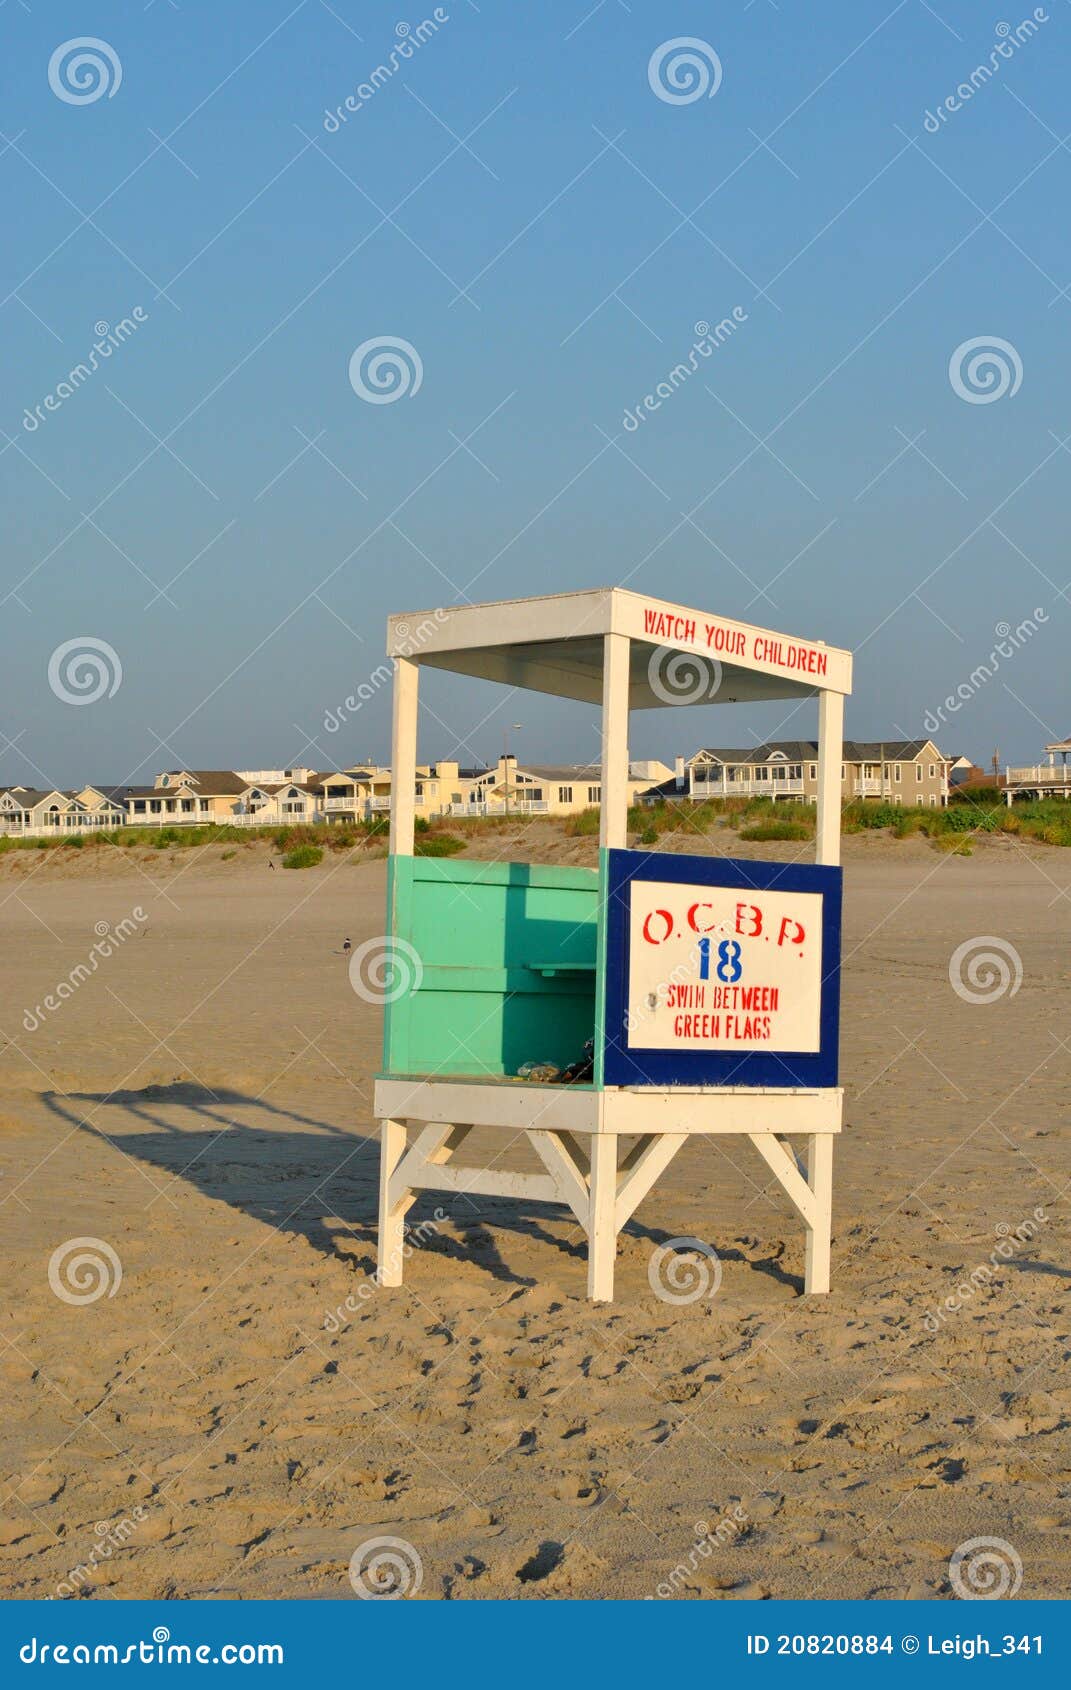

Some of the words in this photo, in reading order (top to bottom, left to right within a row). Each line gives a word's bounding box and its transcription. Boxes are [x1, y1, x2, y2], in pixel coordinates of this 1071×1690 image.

[644, 609, 695, 644] WATCH
[706, 624, 746, 657] YOUR
[754, 637, 828, 676] CHILDREN
[698, 938, 743, 983] 18
[667, 984, 705, 1009] SWIM
[713, 986, 779, 1012] BETWEEN
[674, 1014, 720, 1039] GREEN
[725, 1015, 771, 1040] FLAGS
